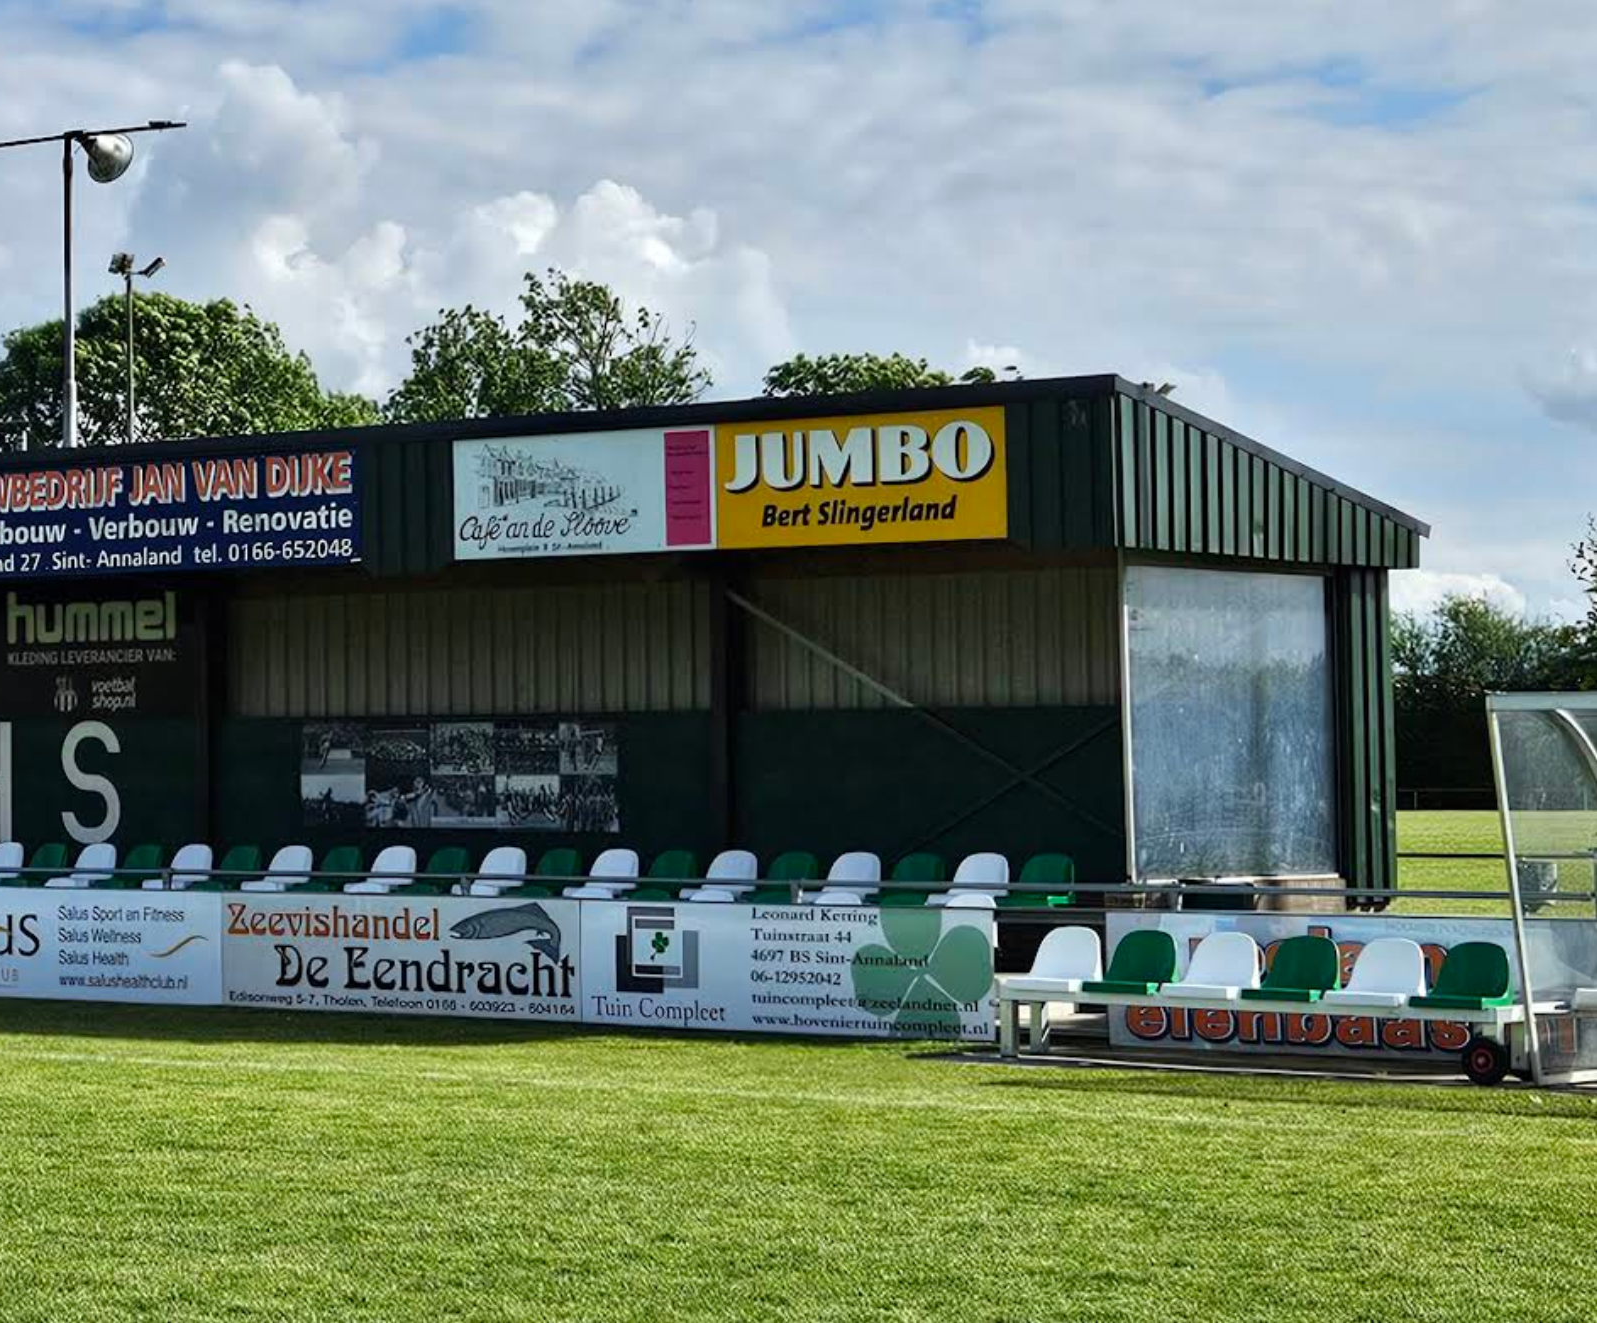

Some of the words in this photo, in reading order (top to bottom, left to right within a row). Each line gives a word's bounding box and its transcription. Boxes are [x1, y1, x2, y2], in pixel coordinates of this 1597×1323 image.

[724, 420, 995, 493] JUMBO
[128, 461, 186, 507] JAN
[191, 457, 258, 502] VAN
[264, 451, 353, 497] DIJKE
[88, 513, 199, 542] Verbouw
[223, 502, 353, 533] Renovatie
[762, 503, 811, 527] Bert
[818, 495, 958, 530] Slingerland
[20, 553, 41, 571] 27
[97, 545, 182, 568] Annaland
[193, 544, 222, 563] tel.
[228, 538, 353, 562] 0166-652048
[7, 591, 176, 644] hummel
[7, 651, 58, 665] KLEDING
[61, 649, 144, 665] LEVERANCIER
[58, 905, 89, 922] Salus
[91, 906, 123, 925] Sport
[143, 906, 185, 923] Fitness
[227, 902, 440, 941] Zeevishandel
[752, 907, 814, 922] Leonard
[58, 927, 89, 944] Salus
[91, 928, 142, 945] Wellness
[750, 928, 830, 943] Tuinstraat
[834, 930, 852, 944] 44
[58, 949, 89, 966] Salus
[92, 951, 129, 967] Health
[750, 950, 783, 963] 4697
[790, 949, 811, 964] BS
[815, 950, 929, 967] Sint-Annaland
[274, 944, 330, 988] De
[343, 946, 576, 998] Eendracht
[750, 971, 842, 986] 06-12952042
[59, 974, 189, 990] www.salushealthclub.nl
[372, 996, 424, 1010] Telefoon
[591, 996, 633, 1017] Tuin
[639, 998, 726, 1026] Compleet
